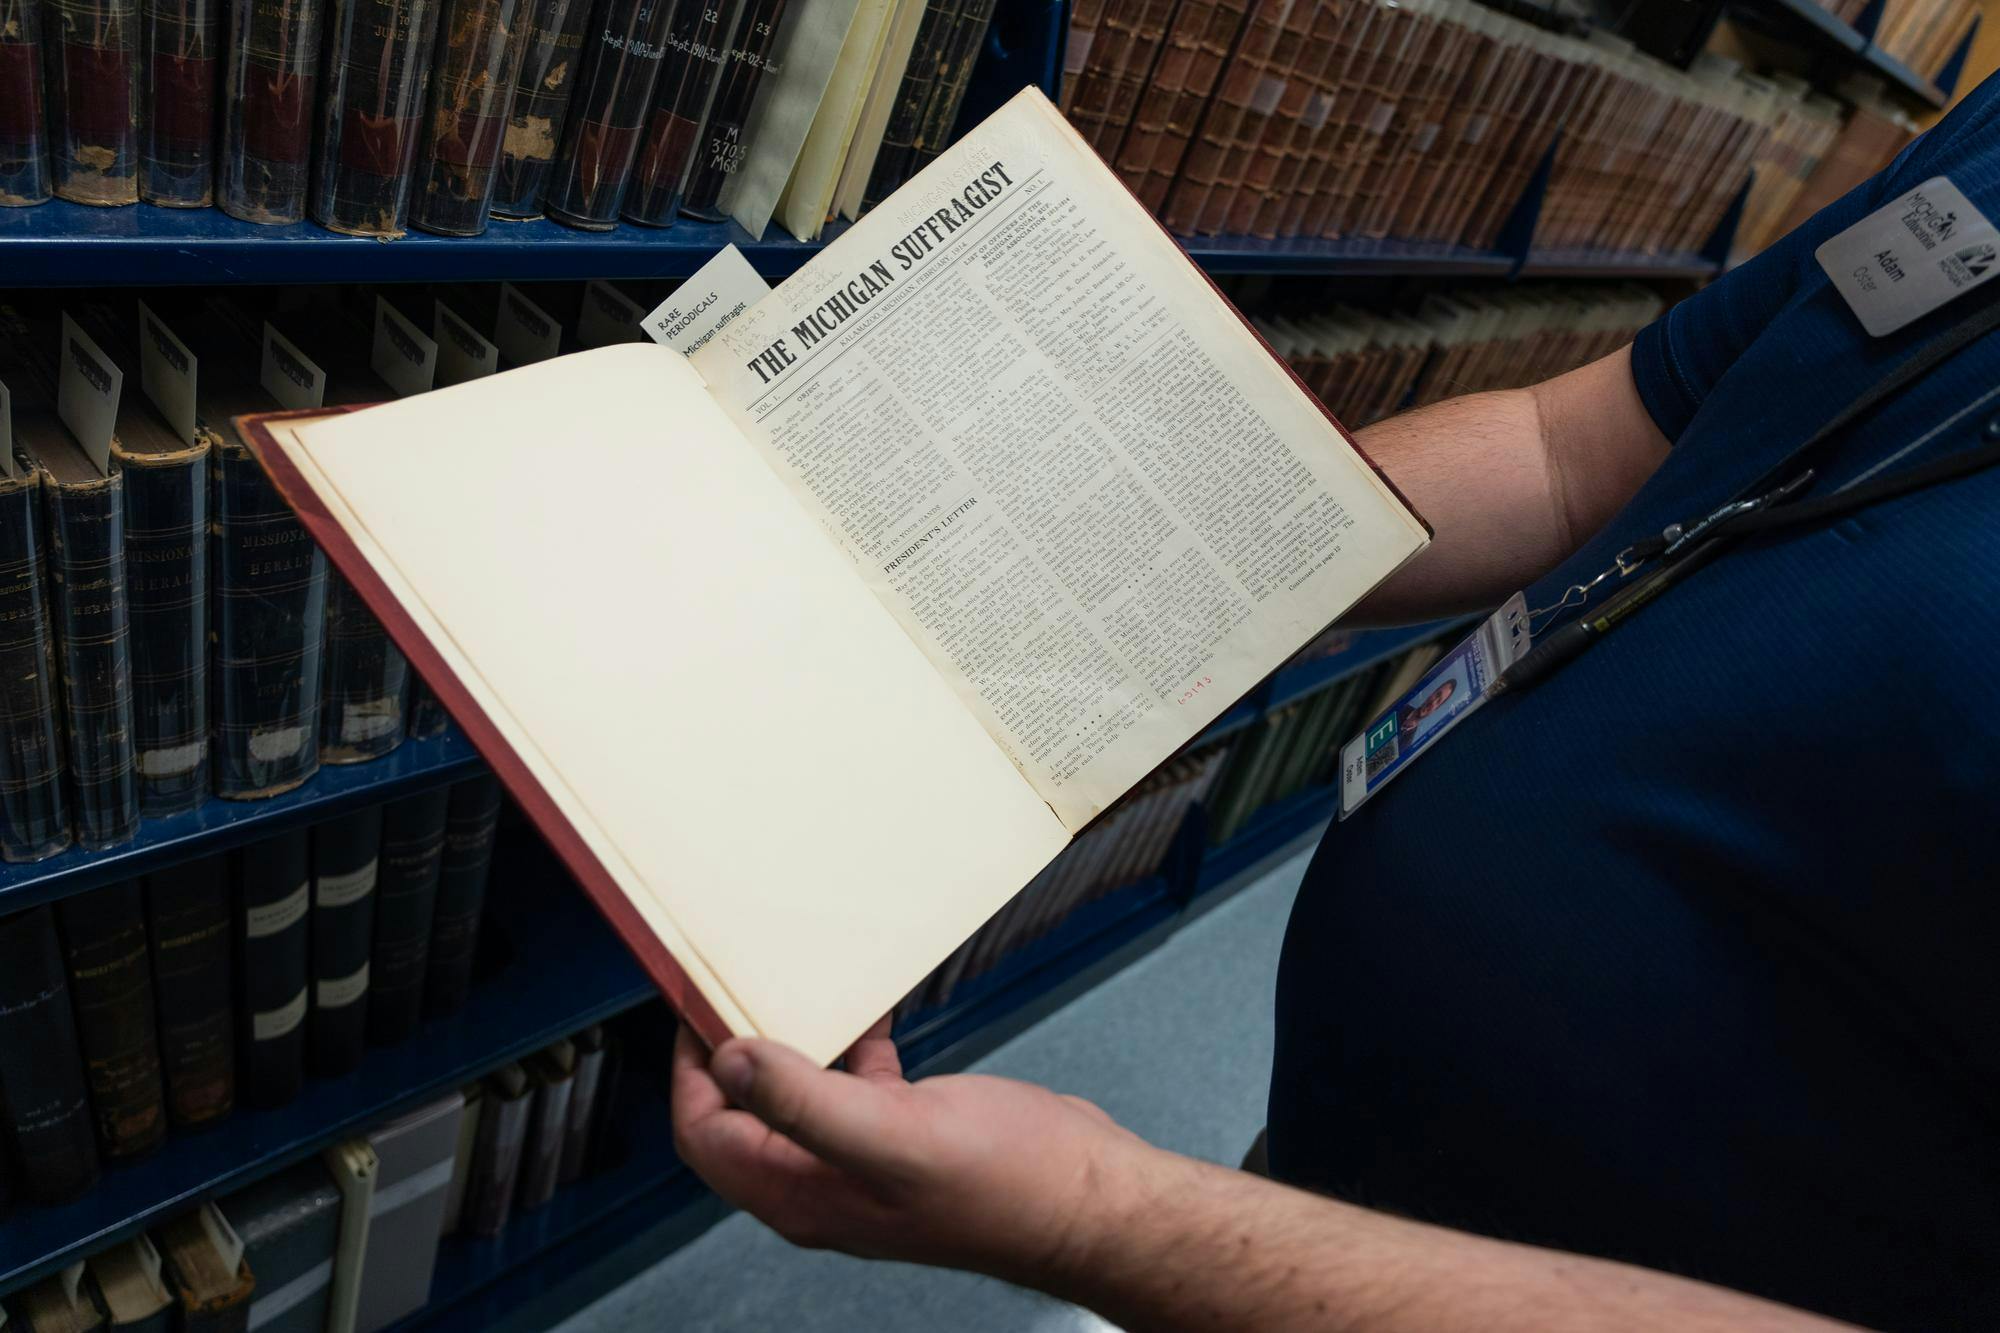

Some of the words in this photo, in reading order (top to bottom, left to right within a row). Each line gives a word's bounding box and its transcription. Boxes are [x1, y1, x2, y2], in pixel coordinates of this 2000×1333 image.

[705, 9, 719, 25] 22
[756, 22, 771, 36] 23
[711, 138, 748, 161] 370.5
[725, 128, 738, 144] M
[710, 157, 738, 175] M68
[963, 252, 979, 266] LIST
[977, 244, 988, 254] OF
[987, 219, 1019, 246] OFFICERS
[1017, 211, 1028, 221] OF
[1027, 199, 1042, 212] THE
[980, 232, 1014, 260] MICHIGAN
[1014, 214, 1037, 233] EQUAL
[982, 249, 1005, 268] FRAGE
[1004, 215, 1047, 250] ASSOCIATION
[1902, 211, 1937, 251] Education
[747, 338, 797, 384] THE
[791, 258, 896, 351] MICHIGAN
[891, 160, 1014, 271] SUFFRAGIST
[914, 253, 953, 285] FEBRUARY,
[1853, 266, 1878, 293] Oster
[1874, 249, 1906, 283] Adam
[657, 308, 682, 331] RARE
[665, 291, 719, 340] PERIODICALS
[682, 328, 717, 359] Michigan
[714, 301, 747, 332] suffragist
[796, 380, 822, 402] OBJECT
[883, 524, 942, 574] PRESIDENT'S
[940, 495, 978, 528] LETTER
[1287, 567, 1315, 591] Continued
[1313, 562, 1322, 570] on
[1321, 551, 1336, 564] page
[1333, 544, 1342, 553] 12
[1370, 719, 1394, 749] E
